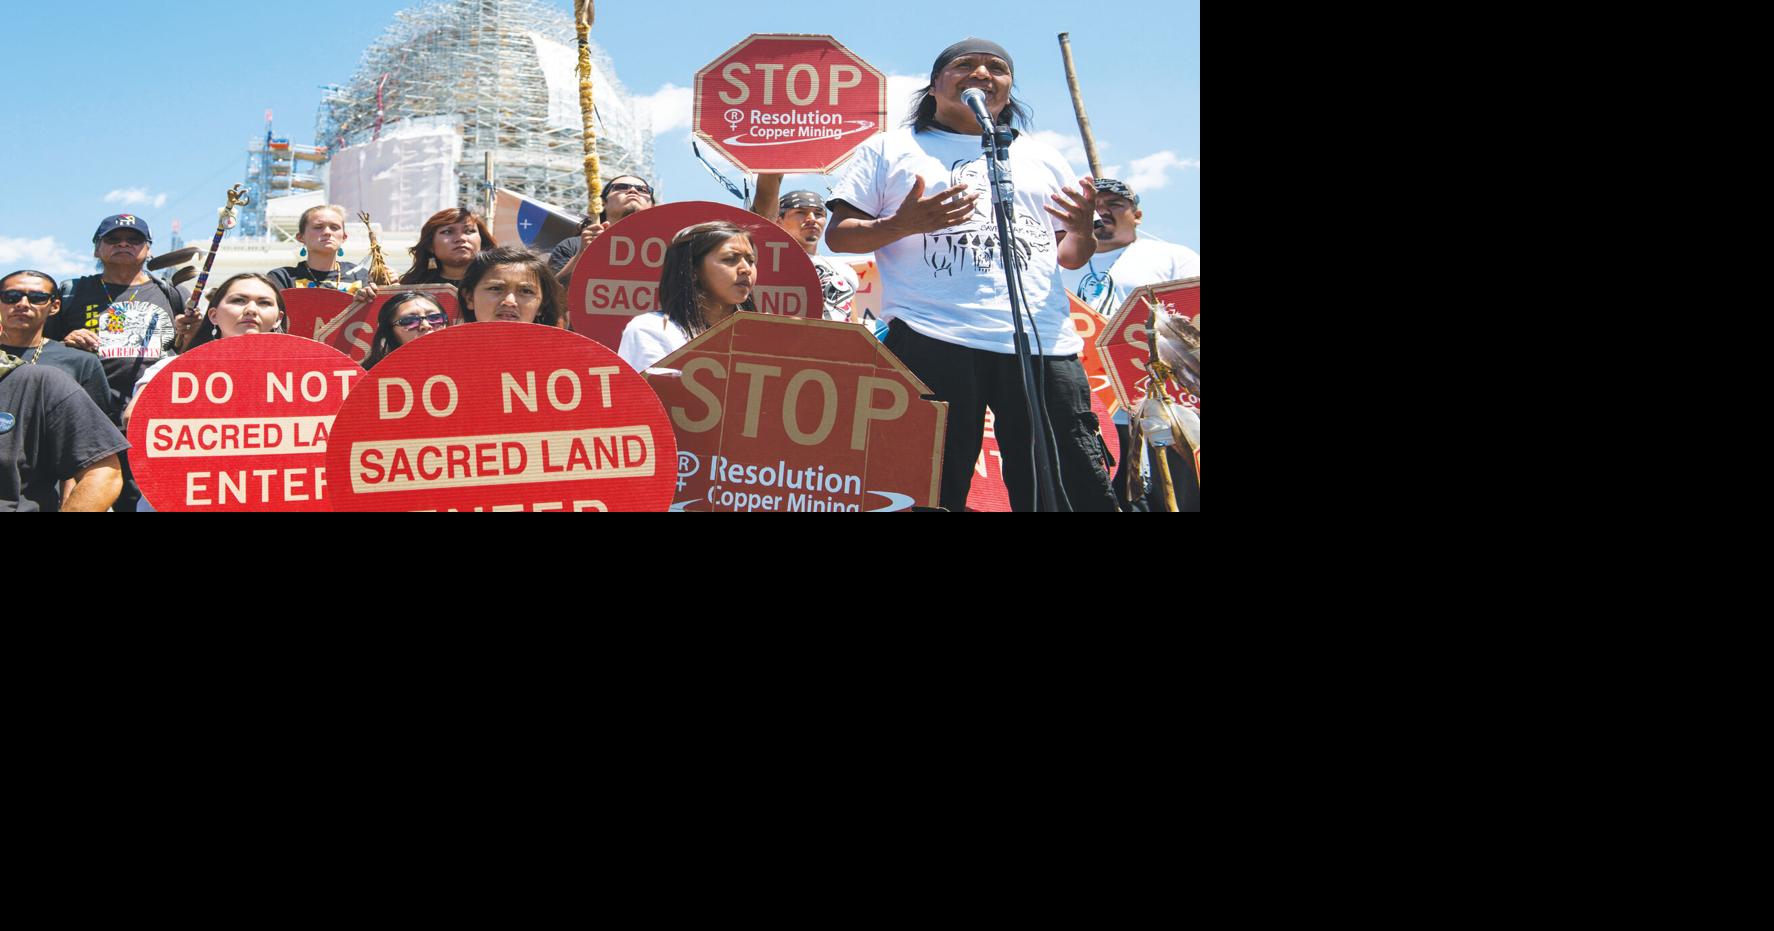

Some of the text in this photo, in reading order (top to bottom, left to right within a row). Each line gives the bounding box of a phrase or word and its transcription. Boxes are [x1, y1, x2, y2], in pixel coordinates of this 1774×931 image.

[718, 62, 862, 107] STOP
[749, 125, 842, 140] Copper Mining
[750, 109, 842, 125] Resolution
[609, 235, 667, 268] DO
[591, 284, 661, 311] SAC
[171, 369, 358, 404] DO NOT
[378, 366, 621, 420] DO NOT
[671, 357, 909, 451] STOP
[153, 421, 330, 451] SACRED LA
[360, 434, 648, 484] SACRED LAND
[709, 455, 862, 496] Resolution
[707, 485, 783, 512] Copper
